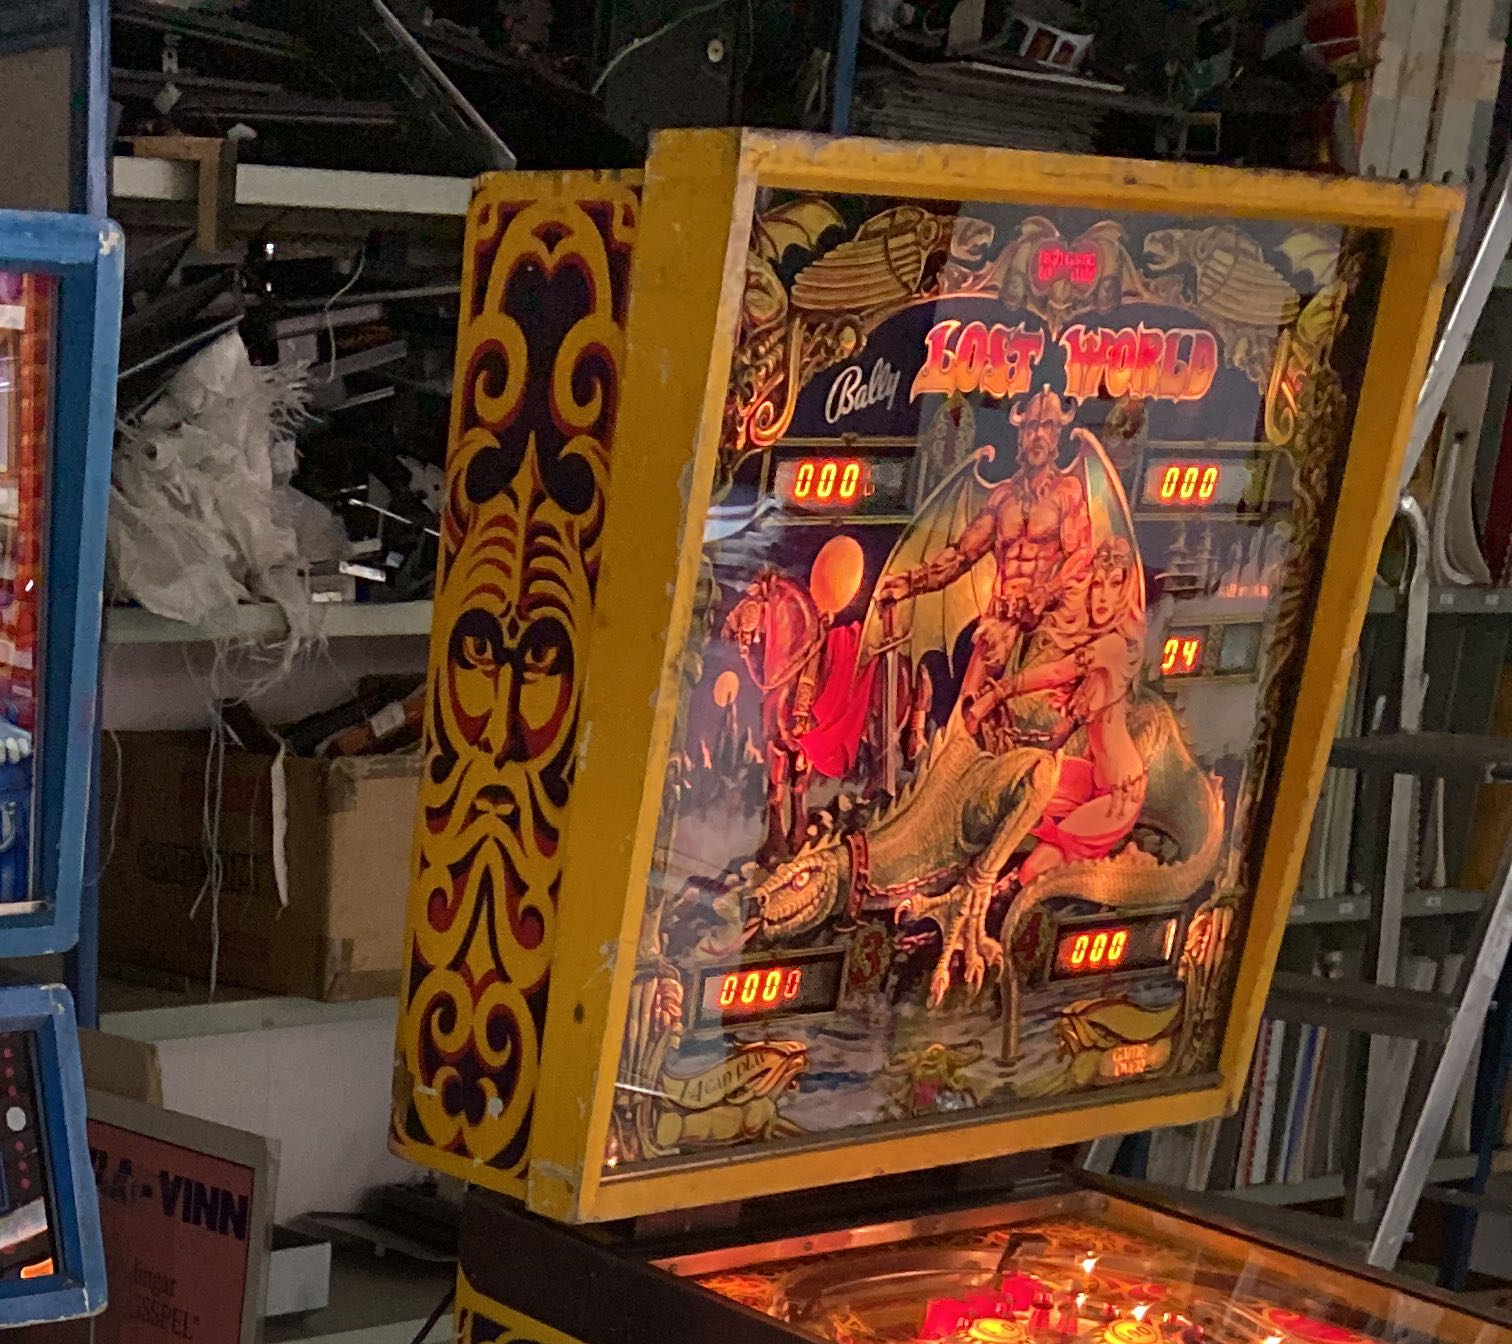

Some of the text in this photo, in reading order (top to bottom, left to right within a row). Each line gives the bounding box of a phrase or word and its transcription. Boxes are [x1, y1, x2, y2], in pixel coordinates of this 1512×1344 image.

[826, 357, 901, 424] Bally
[909, 320, 1220, 404] LOST WORLD
[1161, 466, 1219, 499] 000
[1071, 930, 1128, 964] 000
[159, 1170, 250, 1242] VINN
